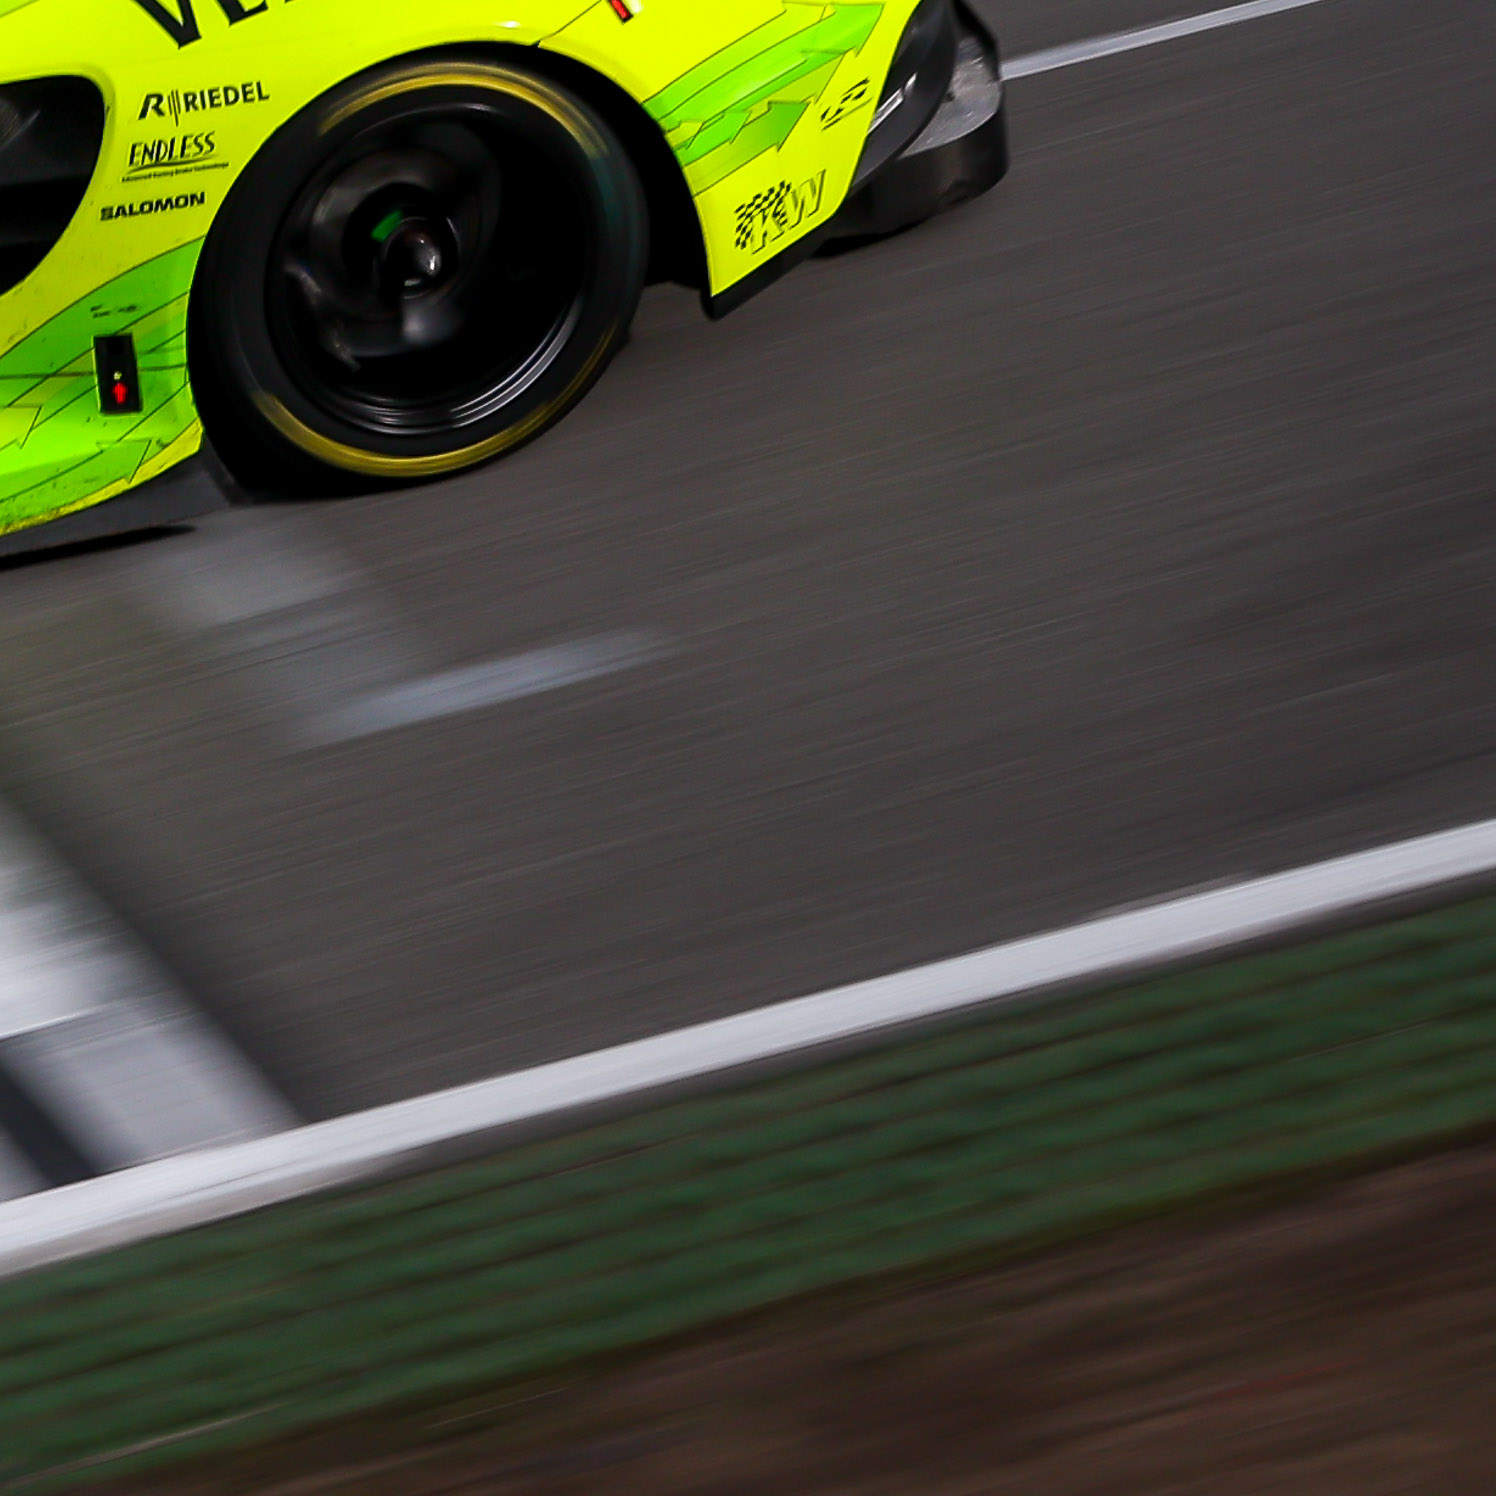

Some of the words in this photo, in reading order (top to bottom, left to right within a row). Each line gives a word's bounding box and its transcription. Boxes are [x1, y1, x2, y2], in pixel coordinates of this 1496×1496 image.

[183, 80, 270, 113] RIEDEL
[127, 130, 216, 167] ENDLESS
[99, 191, 206, 222] SALOMON
[734, 168, 826, 255] KW
